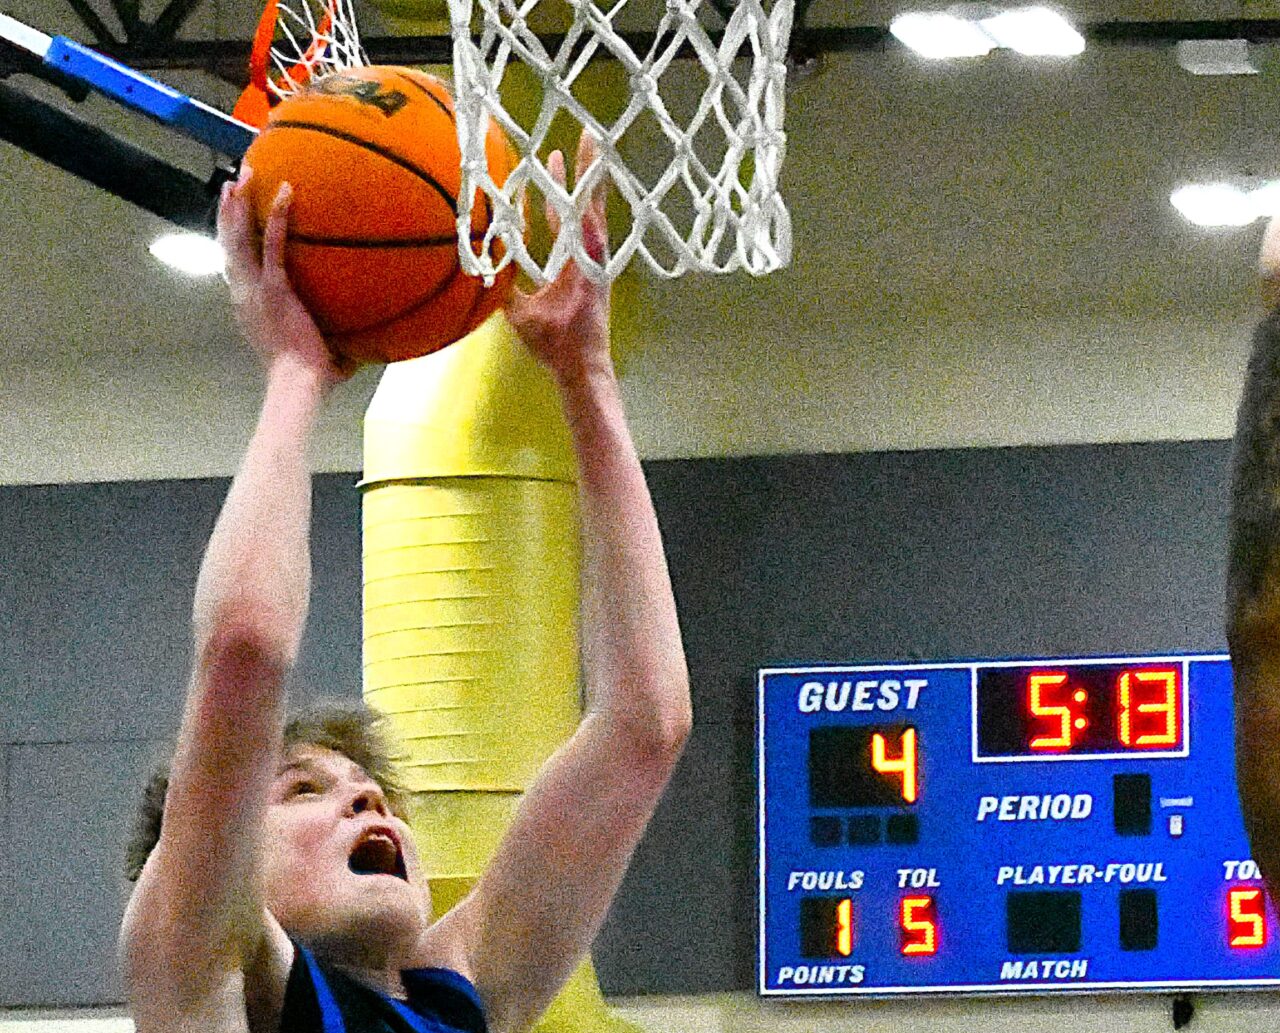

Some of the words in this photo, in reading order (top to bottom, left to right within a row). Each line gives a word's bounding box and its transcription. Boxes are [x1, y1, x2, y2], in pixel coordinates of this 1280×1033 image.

[798, 679, 929, 712] GUEST
[1029, 669, 1178, 748] 5:13
[870, 727, 917, 803] 4
[976, 793, 1093, 821] PERIOD
[787, 870, 865, 891] FOULS
[896, 868, 941, 888] TOL
[996, 862, 1167, 885] PLAYER-FOUL
[836, 898, 851, 956] 1
[901, 897, 936, 955] 5
[1229, 889, 1264, 947] 5
[777, 964, 866, 985] POINTS
[1000, 959, 1088, 980] MATCH
